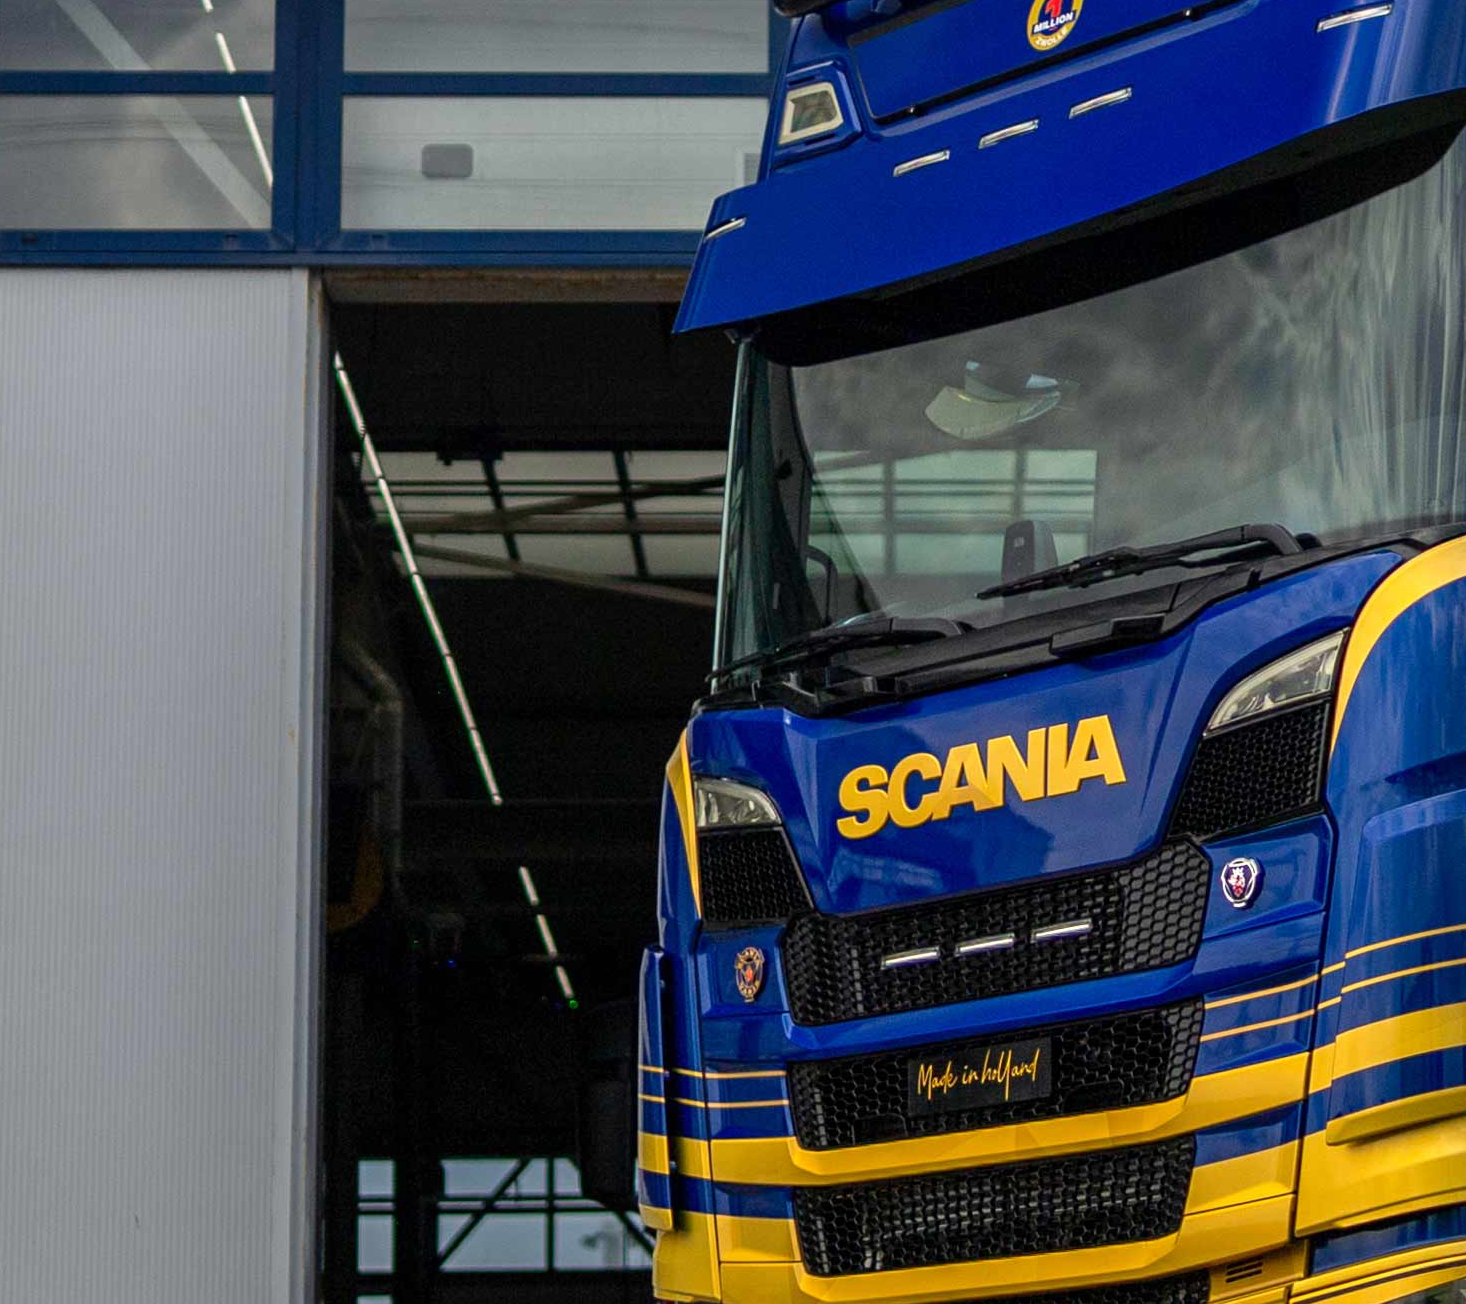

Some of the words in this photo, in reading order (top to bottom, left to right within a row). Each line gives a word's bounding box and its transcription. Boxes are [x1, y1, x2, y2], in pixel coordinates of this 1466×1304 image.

[1034, 11, 1074, 34] MILLION
[836, 714, 1127, 840] SCANIA
[918, 1060, 958, 1101] Made
[962, 1064, 978, 1085] in
